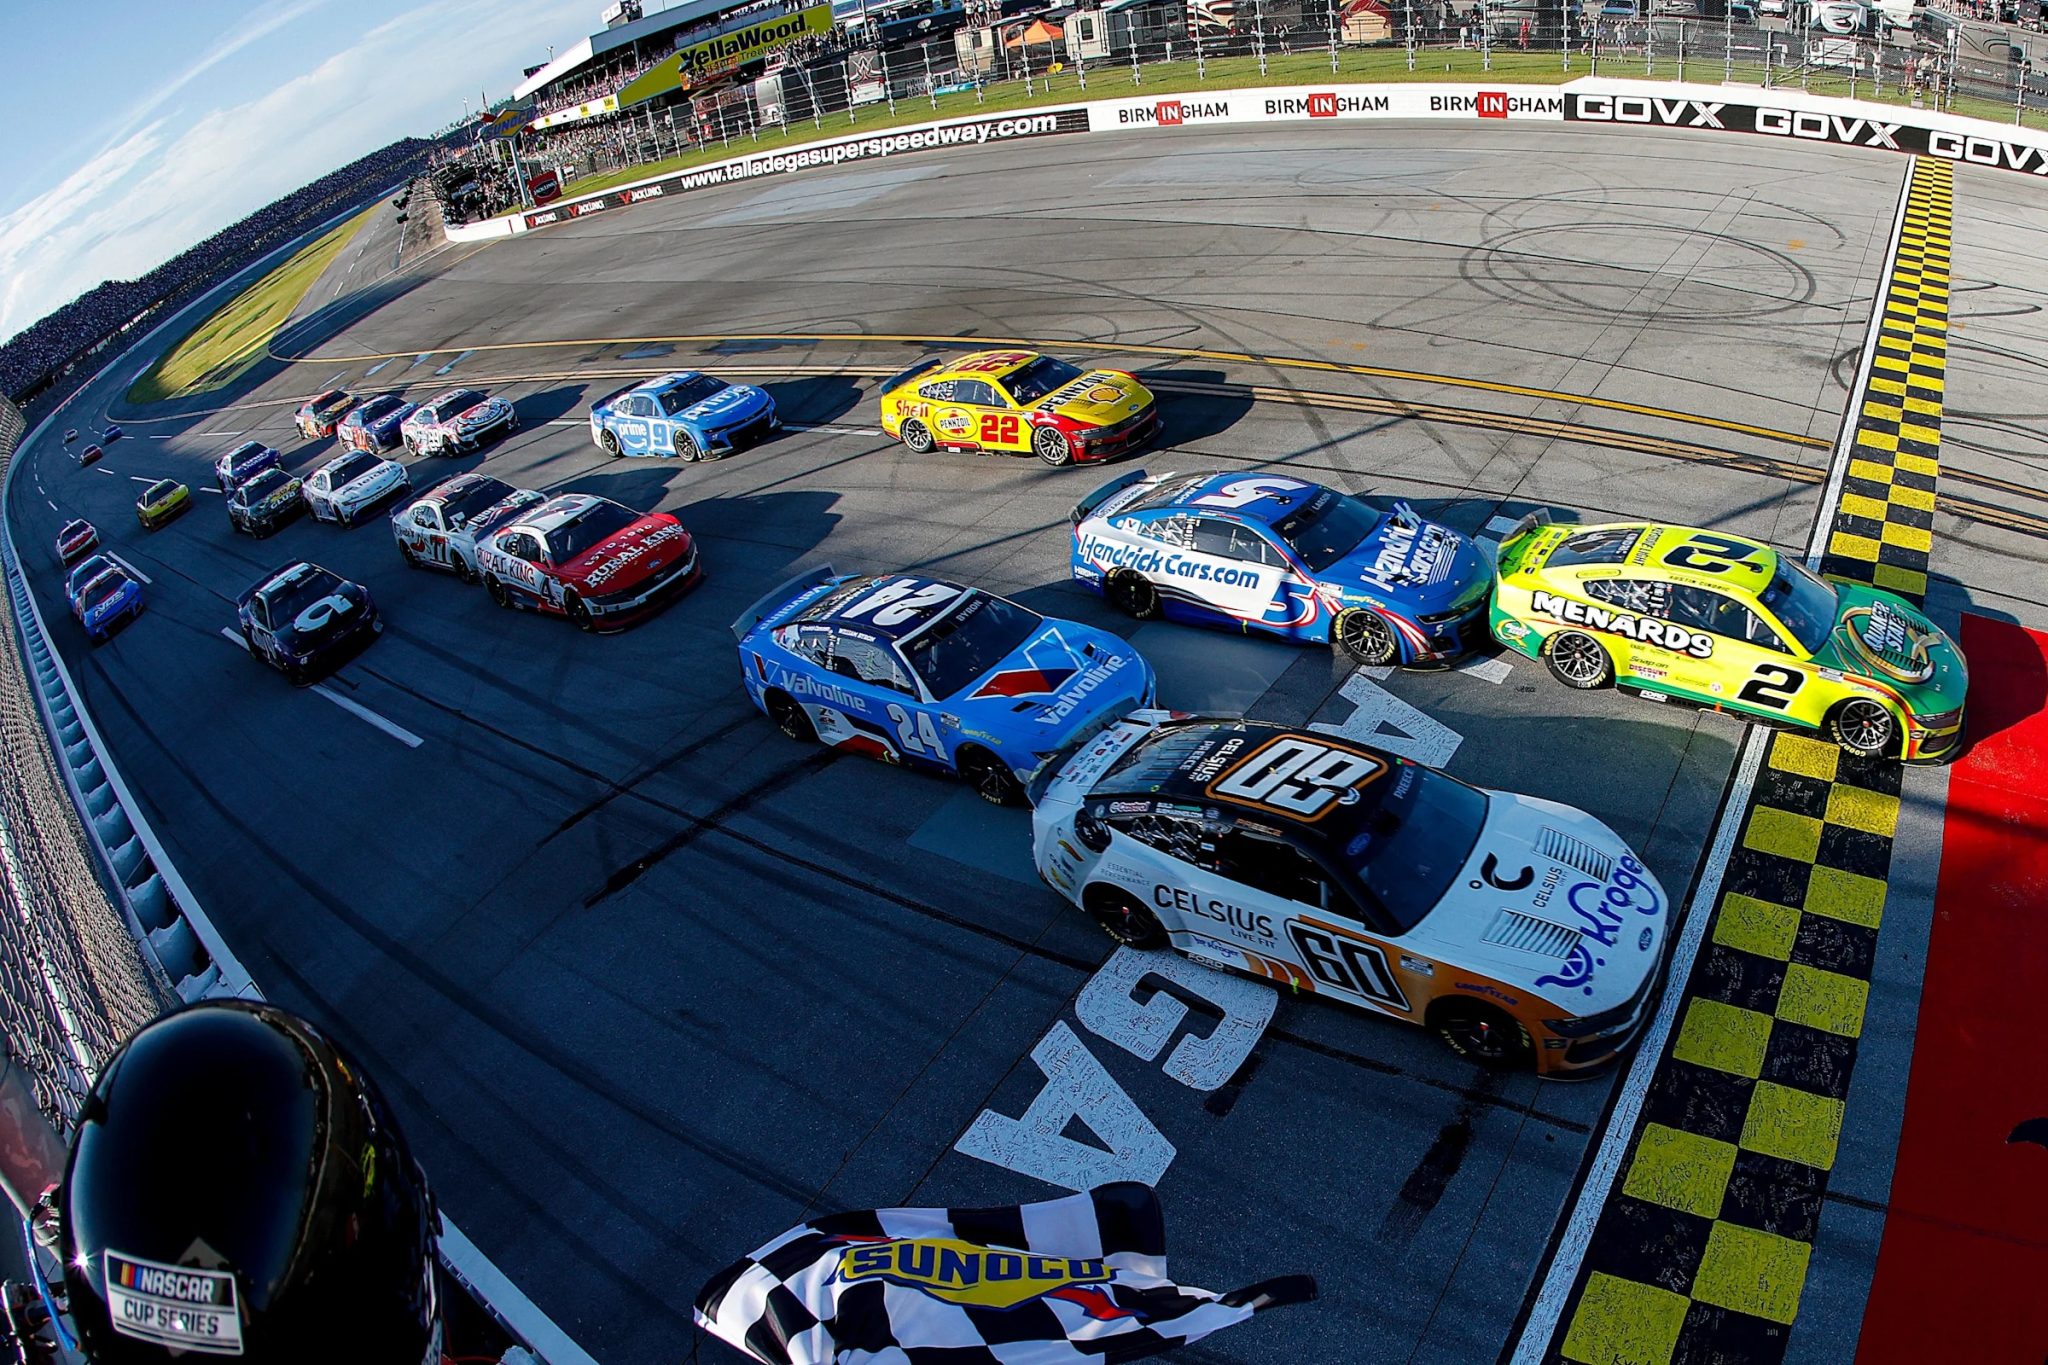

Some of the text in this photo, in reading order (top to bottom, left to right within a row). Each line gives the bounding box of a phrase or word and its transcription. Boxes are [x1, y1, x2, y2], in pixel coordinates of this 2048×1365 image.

[680, 14, 806, 66] YellaWood
[1119, 101, 1229, 124] BIRMINGHAM
[1265, 95, 1389, 115] BIRMINGHAM
[1430, 95, 1563, 115] BIRMINGHAM
[1576, 94, 1725, 130] GOVX
[1755, 107, 1901, 150] GOVX
[681, 114, 1057, 190] www.talladegasuperspeedway.com
[896, 400, 928, 417] Shell
[1036, 373, 1114, 413] PENNZOIL
[618, 421, 647, 438] prime
[653, 423, 667, 447] 9
[940, 417, 970, 428] PENNZOIL
[981, 414, 1018, 444] 22
[510, 559, 536, 586] KING
[583, 524, 685, 588] RURAL KING
[840, 579, 960, 626] 24
[956, 600, 983, 622] BYRON
[1532, 590, 1714, 659] MENARDS
[781, 669, 867, 713] Valvoline
[1034, 655, 1126, 725] Valvoline
[1737, 662, 1806, 709] 2
[887, 703, 949, 761] 24
[1196, 739, 1244, 782] CELSIUS
[1533, 866, 1562, 908] CELSIUS
[1154, 884, 1275, 938] CELSIUS
[1231, 929, 1276, 950] LIVE FIT
[1187, 952, 1224, 969] FORD
[1290, 922, 1405, 1005] 60
[139, 1268, 214, 1304] NASCAR
[848, 1243, 1113, 1290] SUNOCO
[124, 1298, 219, 1336] CUP SERIES
